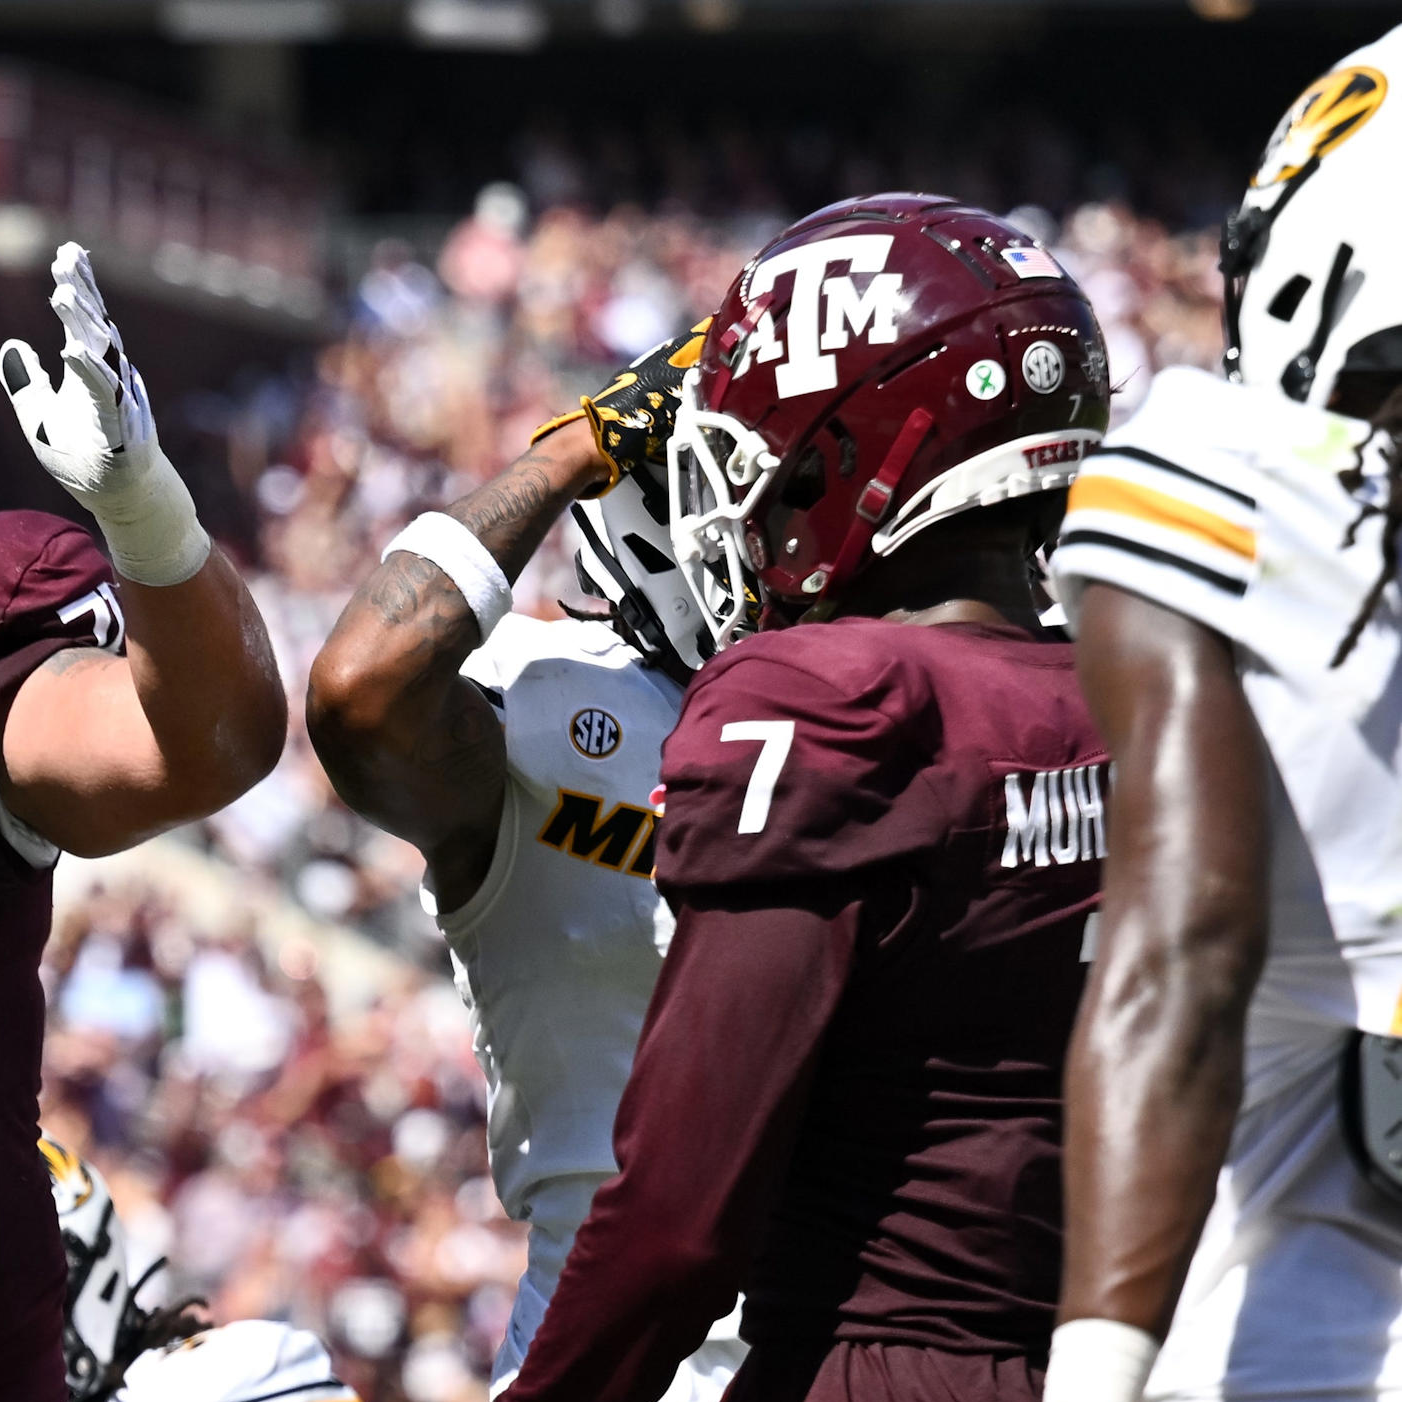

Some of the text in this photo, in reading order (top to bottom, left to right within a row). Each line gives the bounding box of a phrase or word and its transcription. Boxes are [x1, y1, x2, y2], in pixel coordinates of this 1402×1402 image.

[572, 710, 620, 757] SEC
[720, 719, 795, 835] 7
[999, 764, 1117, 868] MUH
